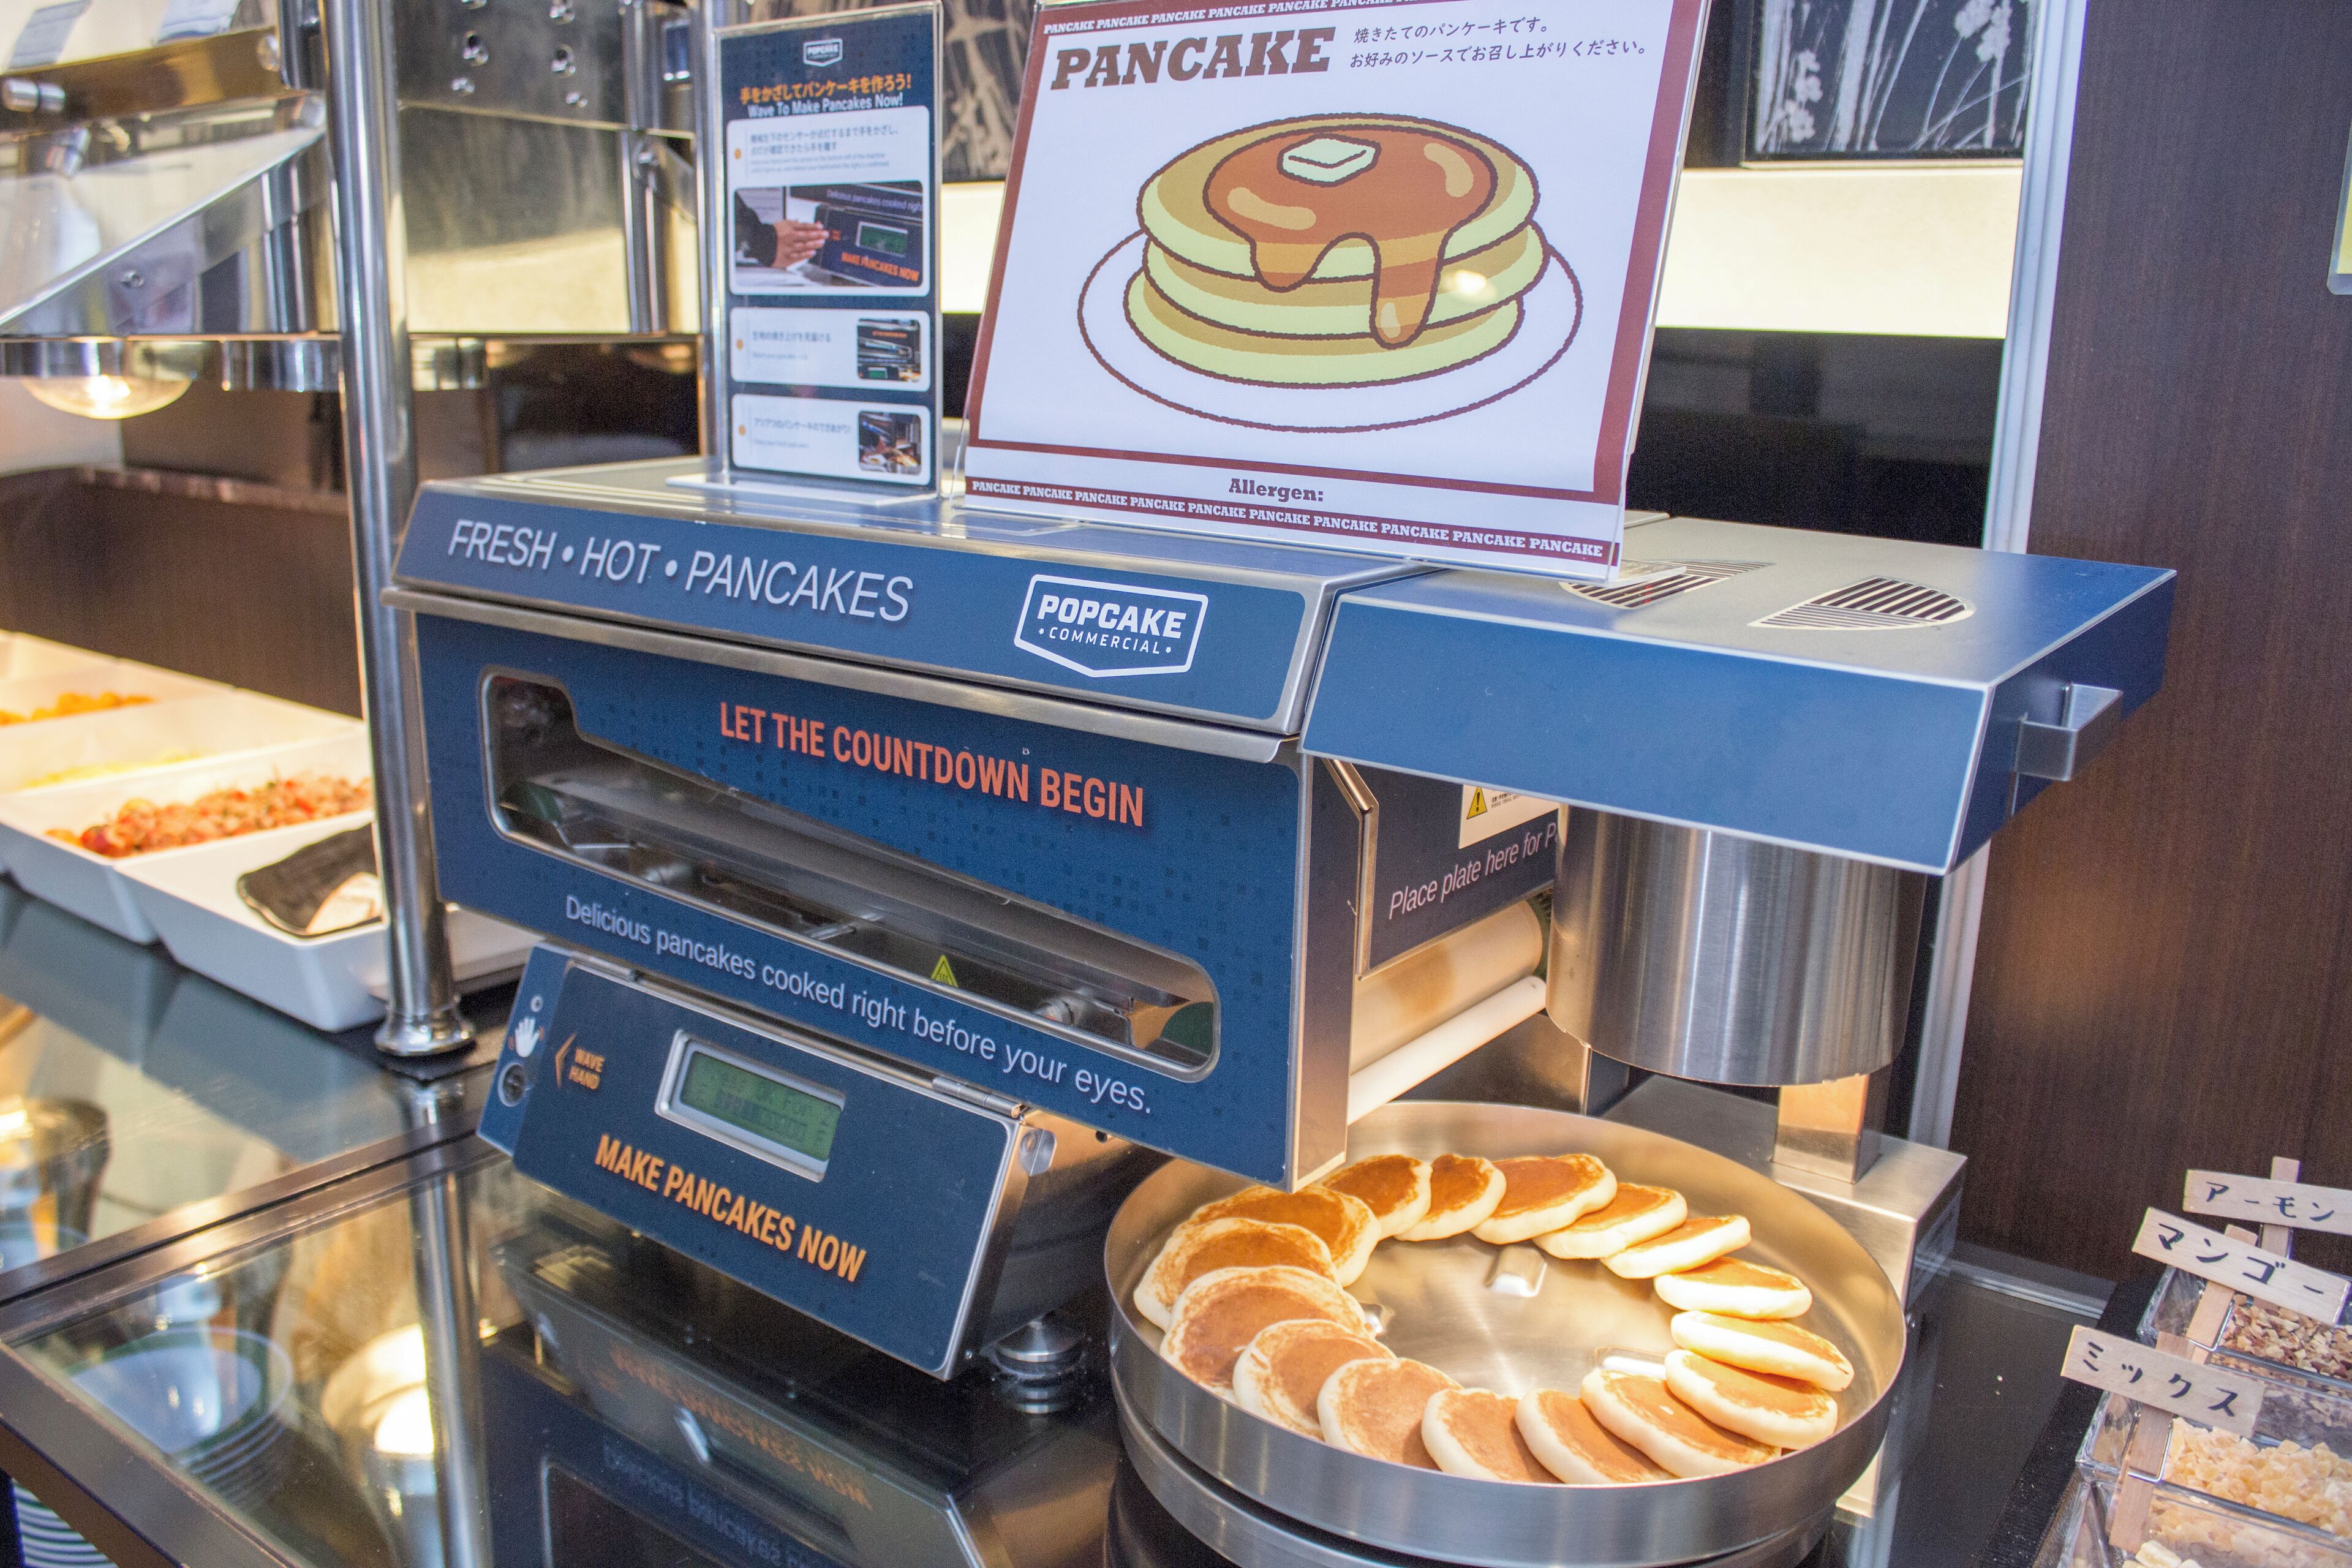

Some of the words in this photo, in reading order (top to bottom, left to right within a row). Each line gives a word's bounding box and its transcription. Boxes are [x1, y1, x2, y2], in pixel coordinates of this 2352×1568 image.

[1043, 20, 1095, 34] PANCAKE
[1097, 15, 1148, 29] PANCAKE
[1151, 10, 1206, 23] PANCAKE
[1208, 5, 1265, 18] PANCAKE
[1268, 0, 1327, 13] PANCAKE
[1353, 17, 1548, 43] 焼きたてのパンケーキです。
[1050, 26, 1336, 90] PANCAKE
[1350, 39, 1646, 69] お好みのソースでお召し上がりください。
[747, 105, 775, 118] Wave
[776, 101, 790, 116] To
[791, 99, 820, 115] Make
[822, 96, 872, 112] Pancakes
[875, 92, 903, 108] Now!
[972, 480, 1021, 496] PANCAKE
[1022, 485, 1073, 501] PANCAKE
[1074, 491, 1128, 507] PANCAKE
[1129, 496, 1186, 513] PANCAKE
[1188, 502, 1247, 519] PANCAKE
[1249, 509, 1311, 526] PANCAKE
[1313, 516, 1379, 533] PANCAKE
[1381, 523, 1450, 541] PANCAKE
[1452, 530, 1526, 549] PANCAKE
[1529, 537, 1603, 557] PANCAKE
[1229, 477, 1324, 503] Allergen:
[448, 519, 557, 570] FRESH
[579, 536, 660, 584] HOT
[684, 549, 914, 622] PANCAKES
[1037, 594, 1187, 639] POPCAKE
[1049, 626, 1159, 654] COMMERCIAL
[720, 702, 766, 744] LET
[771, 713, 826, 758] THE
[832, 726, 1029, 802] COUNTDOWN
[1040, 767, 1144, 827] BEGIN
[1389, 880, 1438, 920] Place
[1441, 860, 1481, 903] plate
[1485, 843, 1519, 876] here
[1523, 831, 1543, 859] for
[565, 895, 651, 945] Delicious
[657, 931, 756, 980] pancakes
[761, 963, 845, 1010] cooked
[851, 991, 905, 1031] right
[913, 1007, 997, 1060] before
[1002, 1044, 1067, 1084] your
[1075, 1068, 1152, 1114] eyes.
[594, 1133, 665, 1192] MAKE
[662, 1164, 797, 1252] PANCAKES
[796, 1224, 867, 1283] NOW
[2205, 1181, 2335, 1222] アーモン
[2158, 1223, 2324, 1295] マンゴー
[2083, 1341, 2239, 1417] ミックス
